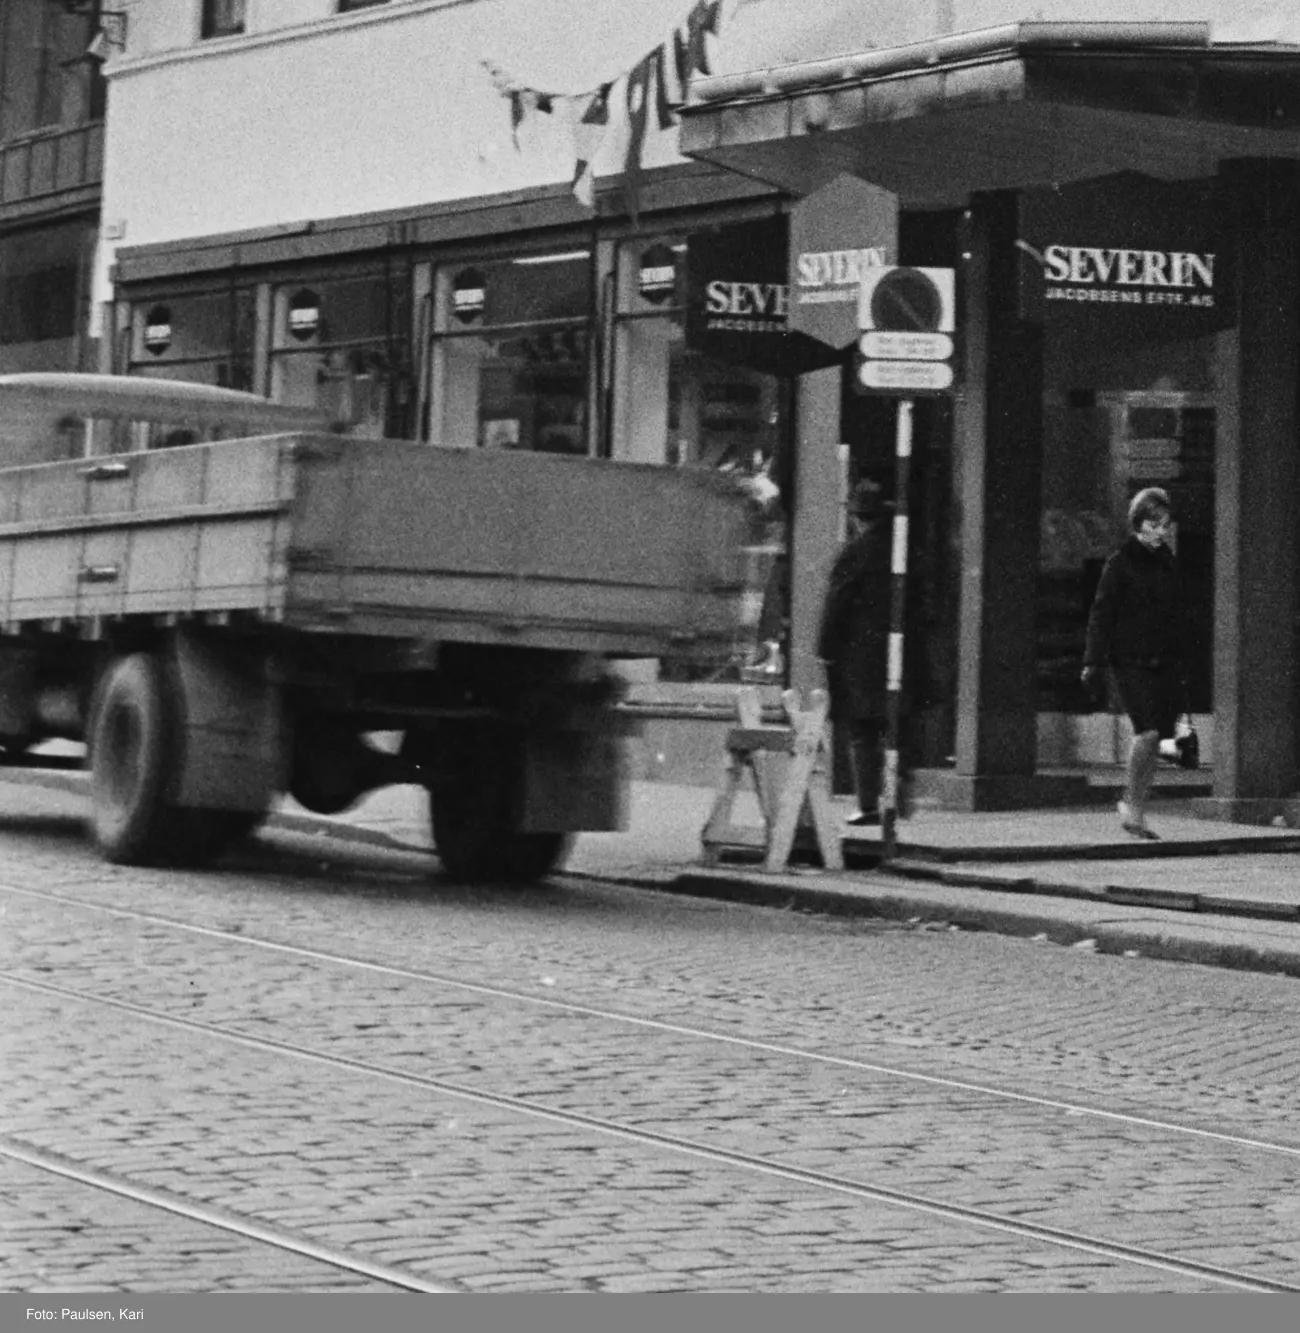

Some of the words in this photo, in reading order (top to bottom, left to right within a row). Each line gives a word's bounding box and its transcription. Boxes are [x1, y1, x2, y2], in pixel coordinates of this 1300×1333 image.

[1044, 244, 1216, 288] SEVERIN
[706, 280, 789, 313] SEVE
[1044, 286, 1142, 304] JACOBSENS
